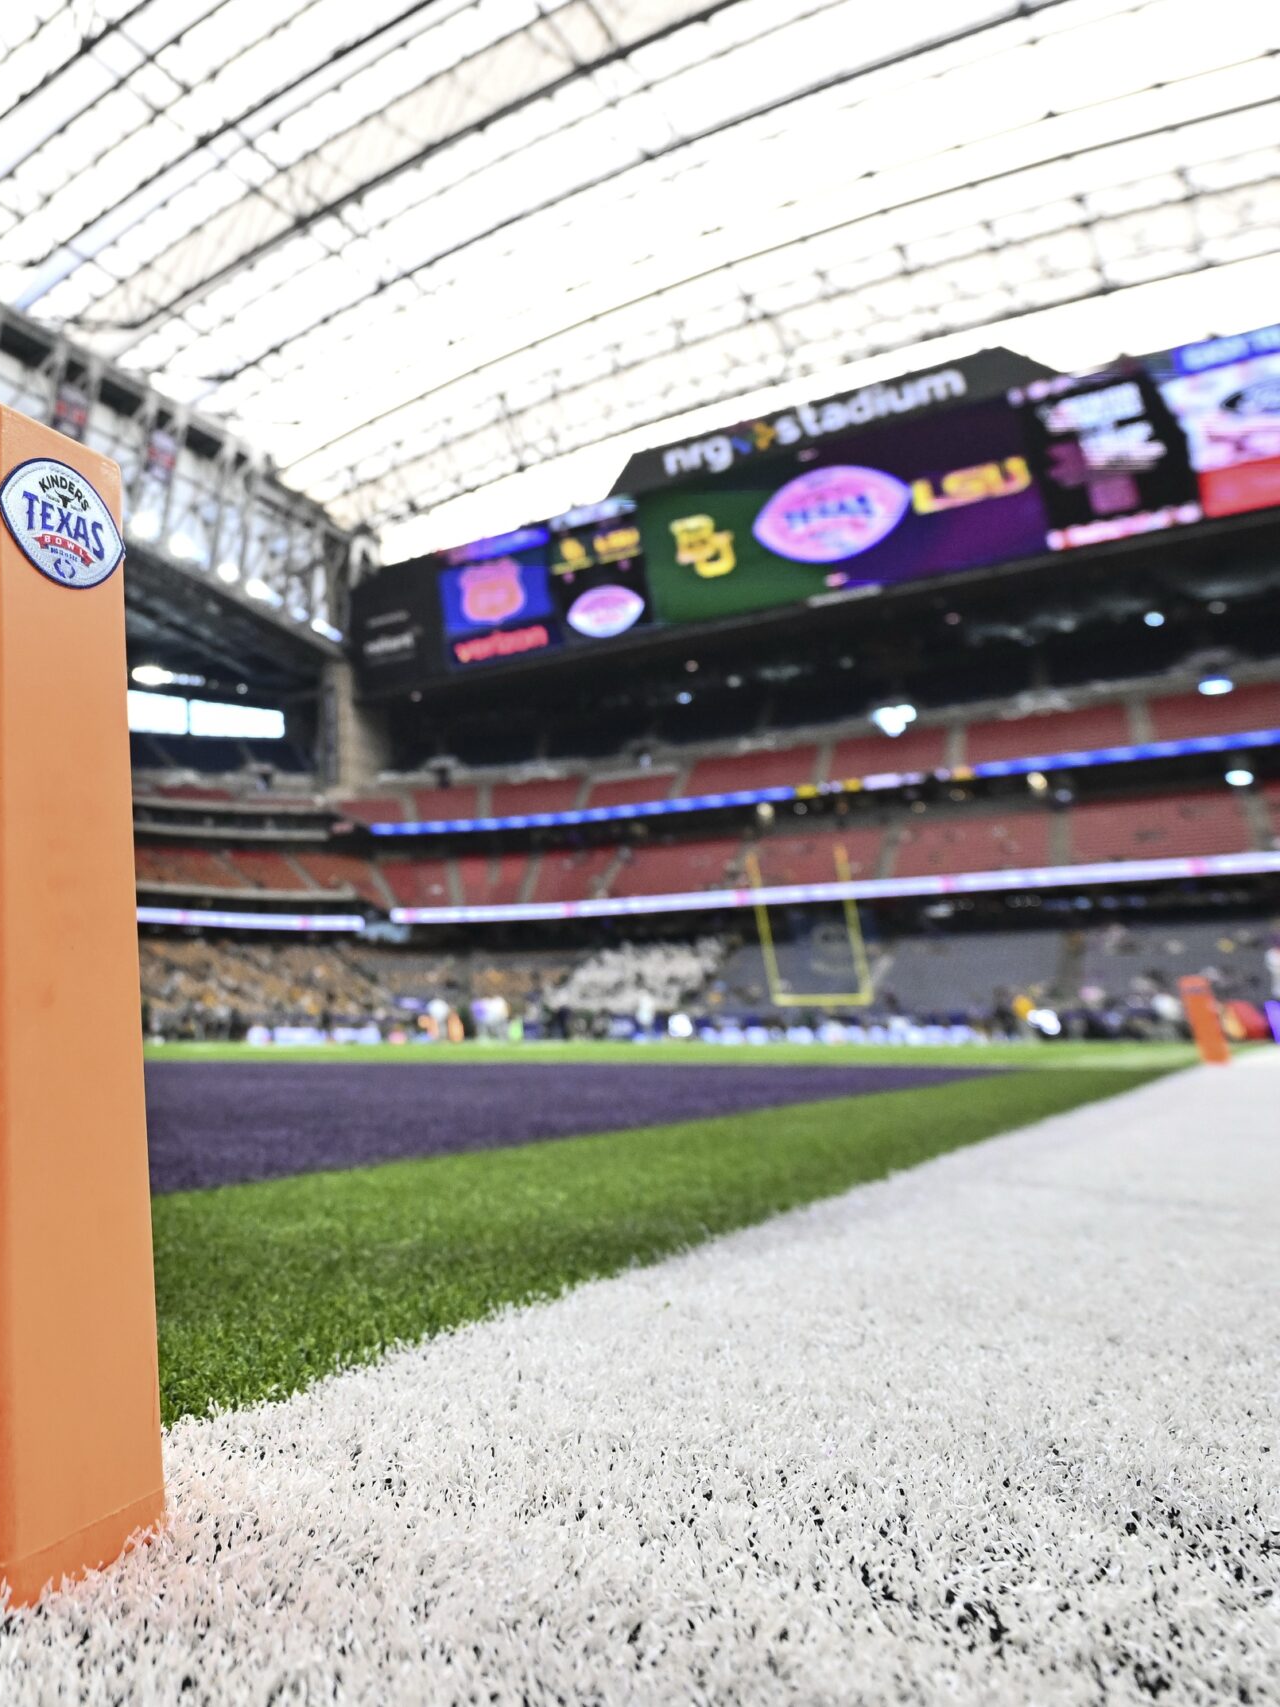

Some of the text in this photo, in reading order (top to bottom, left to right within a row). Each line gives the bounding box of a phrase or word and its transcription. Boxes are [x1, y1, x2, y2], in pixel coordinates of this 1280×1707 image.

[663, 369, 968, 475] nrg stadium
[38, 474, 89, 511] KINDER'S
[912, 456, 1032, 516] LSU
[22, 490, 105, 561] TEXAS
[44, 535, 86, 558] BOWL
